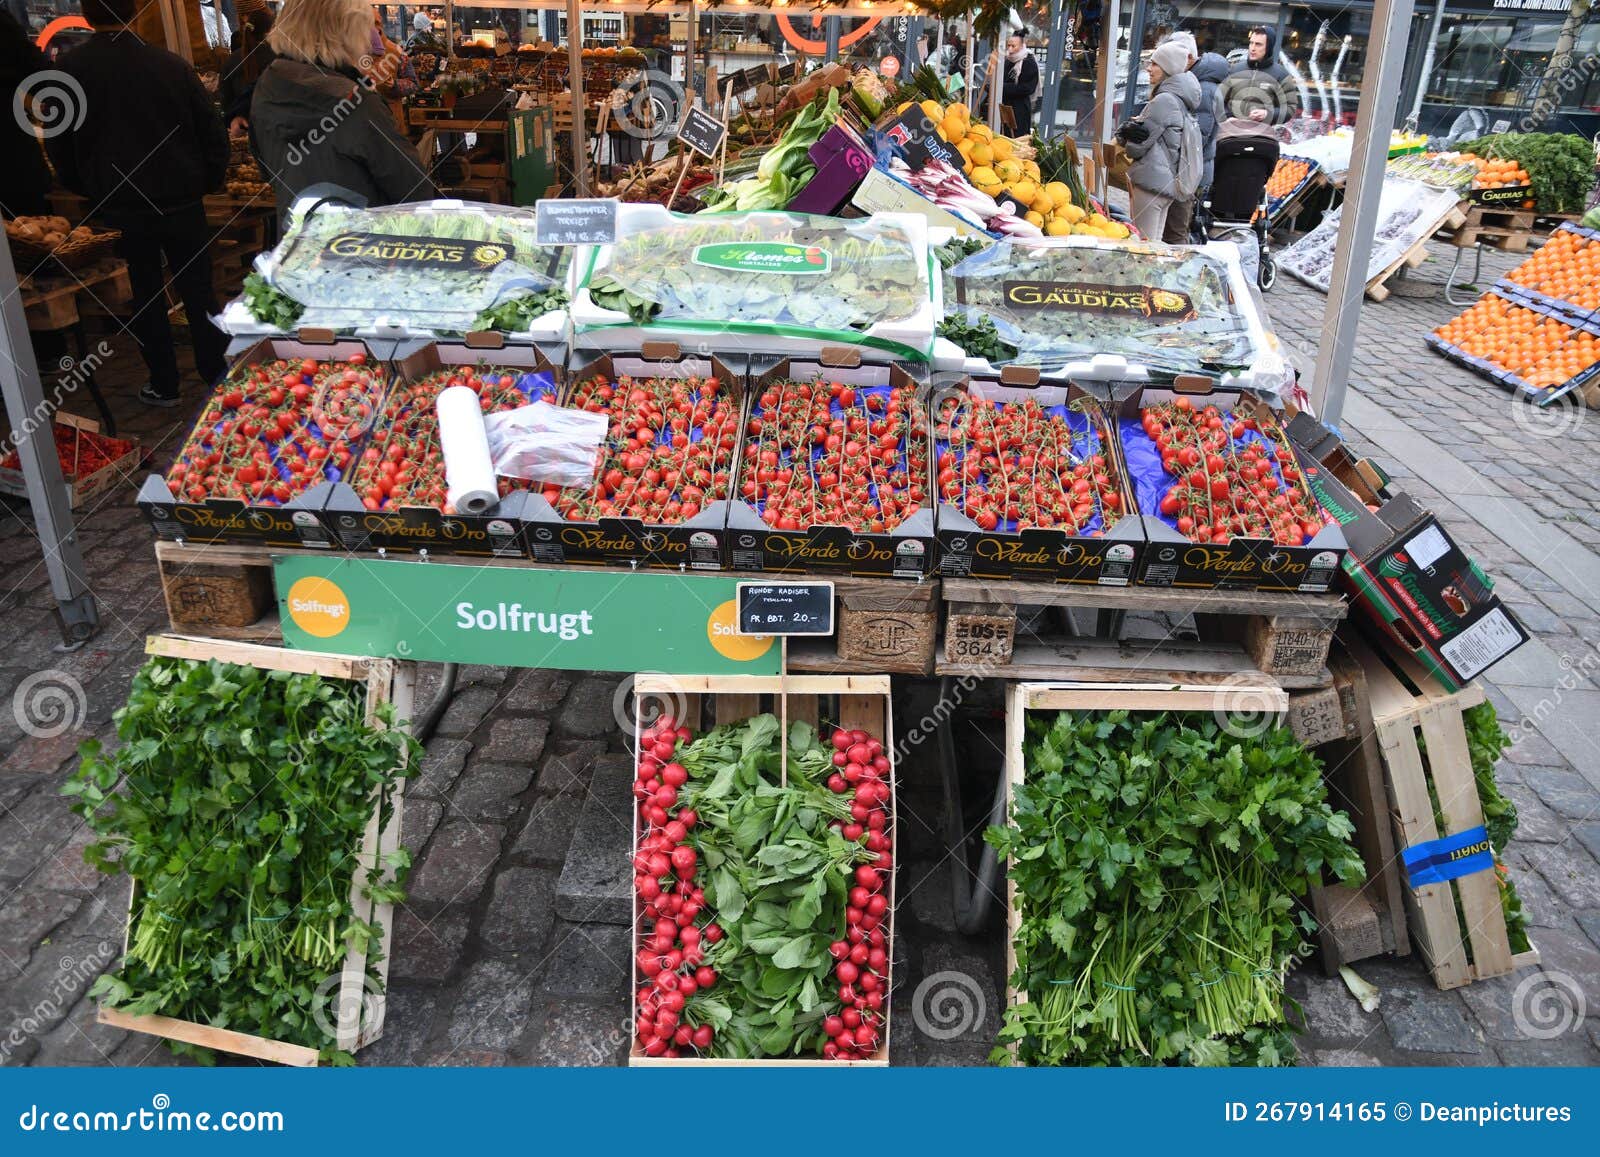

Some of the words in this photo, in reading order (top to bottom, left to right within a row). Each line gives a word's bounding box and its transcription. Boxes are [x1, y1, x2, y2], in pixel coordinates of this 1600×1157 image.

[1482, 190, 1523, 200] GAUDIAS
[330, 236, 464, 262] GAUDIAS
[1009, 286, 1143, 309] GAUDIAS
[174, 506, 245, 528] Verde
[250, 511, 293, 531] Oro
[363, 515, 436, 537] Verde
[442, 519, 485, 540] Oro
[560, 528, 635, 550] Verde
[642, 531, 687, 552] Oro
[764, 535, 839, 558] Verde
[848, 538, 892, 560] Oro
[976, 538, 1050, 563] Verde
[1056, 543, 1101, 567] Oro
[1184, 548, 1253, 571] Verde
[1261, 551, 1305, 573] Oro
[293, 599, 345, 618] Solfrugt
[456, 602, 593, 640] Solfrugt
